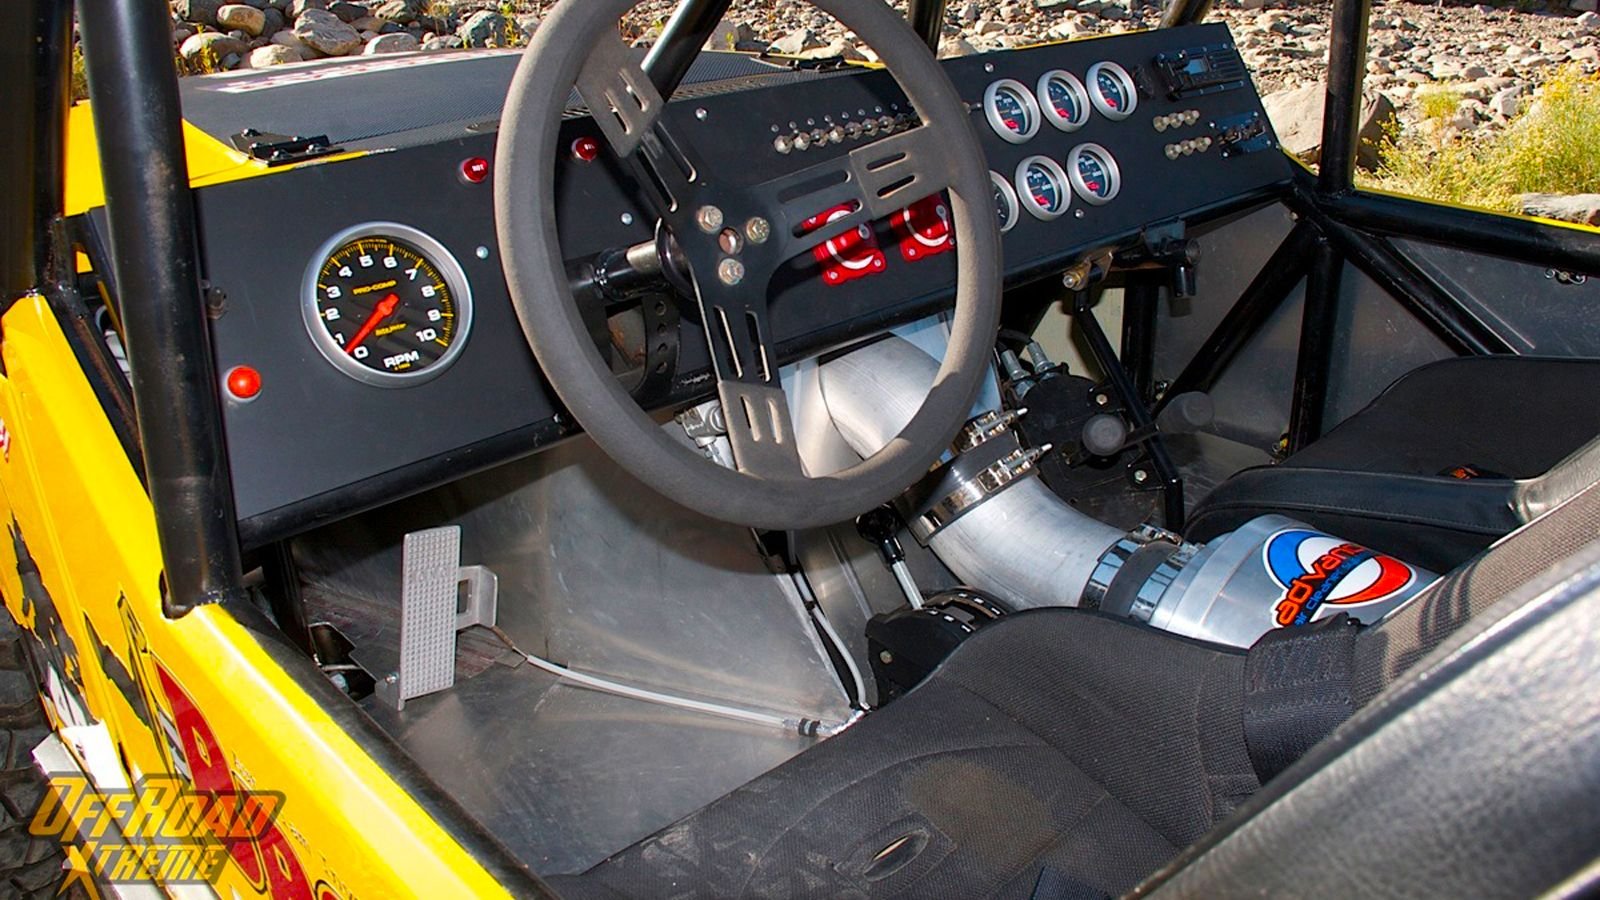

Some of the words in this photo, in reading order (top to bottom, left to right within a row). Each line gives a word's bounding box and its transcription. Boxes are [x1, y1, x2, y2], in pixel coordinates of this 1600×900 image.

[359, 255, 373, 267] 5
[383, 256, 398, 268] 6
[338, 266, 352, 277] 4
[405, 268, 418, 280] 7
[326, 286, 341, 298] 3
[352, 279, 397, 295] PRO-COMP
[421, 285, 435, 297] 8
[325, 308, 340, 320] 2
[427, 309, 441, 321] 9
[335, 333, 345, 344] 1
[416, 328, 437, 342] 10
[354, 346, 368, 359] 0
[383, 350, 419, 368] RPM
